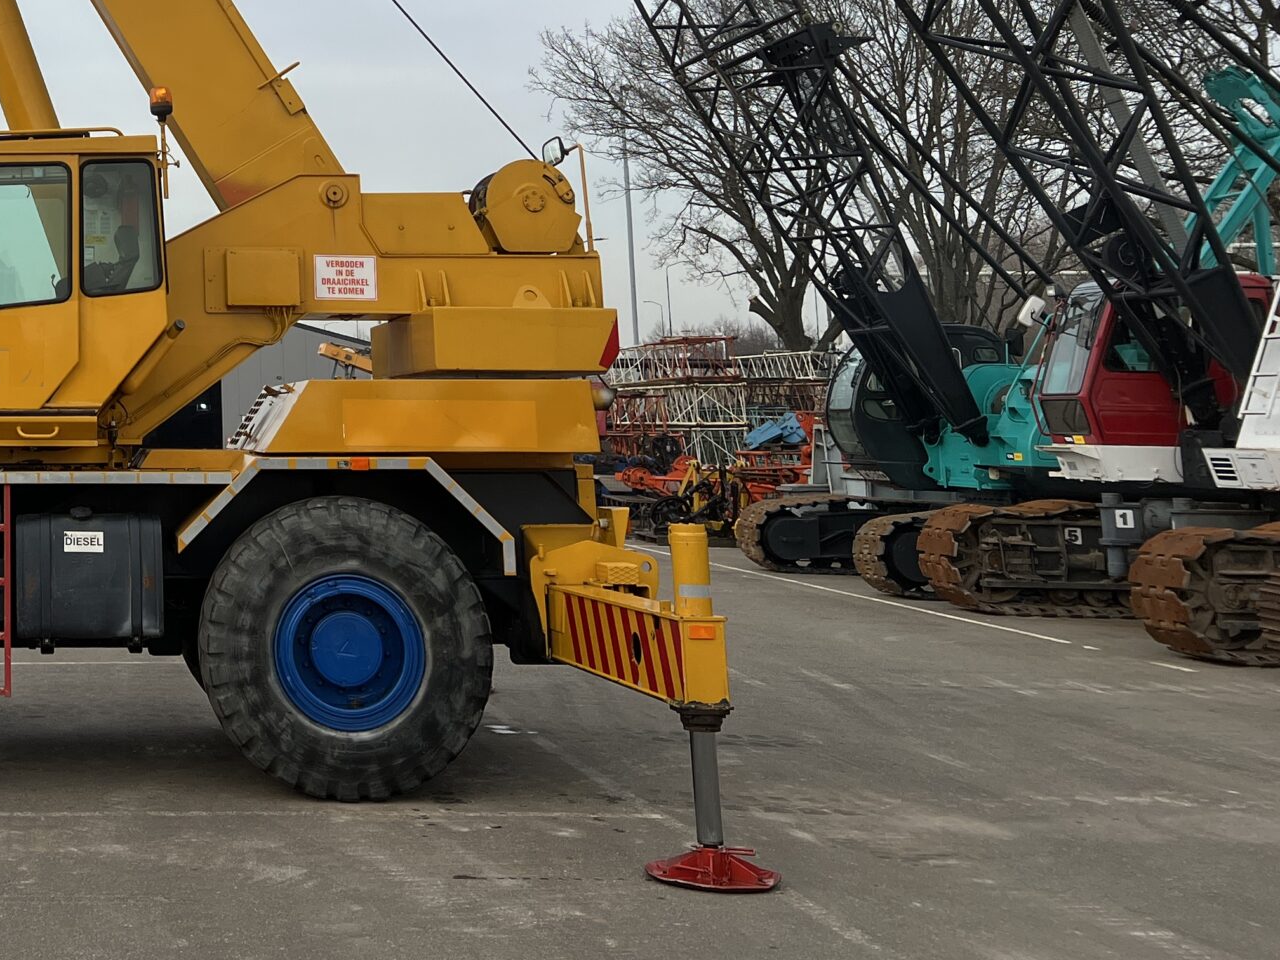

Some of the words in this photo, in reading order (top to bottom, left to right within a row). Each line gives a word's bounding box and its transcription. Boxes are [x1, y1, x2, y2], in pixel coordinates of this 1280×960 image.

[326, 260, 364, 268] VERBODEN
[321, 278, 369, 286] DRAAICIRKEL
[338, 287, 365, 295] KOMEN
[1119, 512, 1128, 526] 1
[1067, 529, 1079, 542] 5
[65, 537, 103, 546] DIESEL
